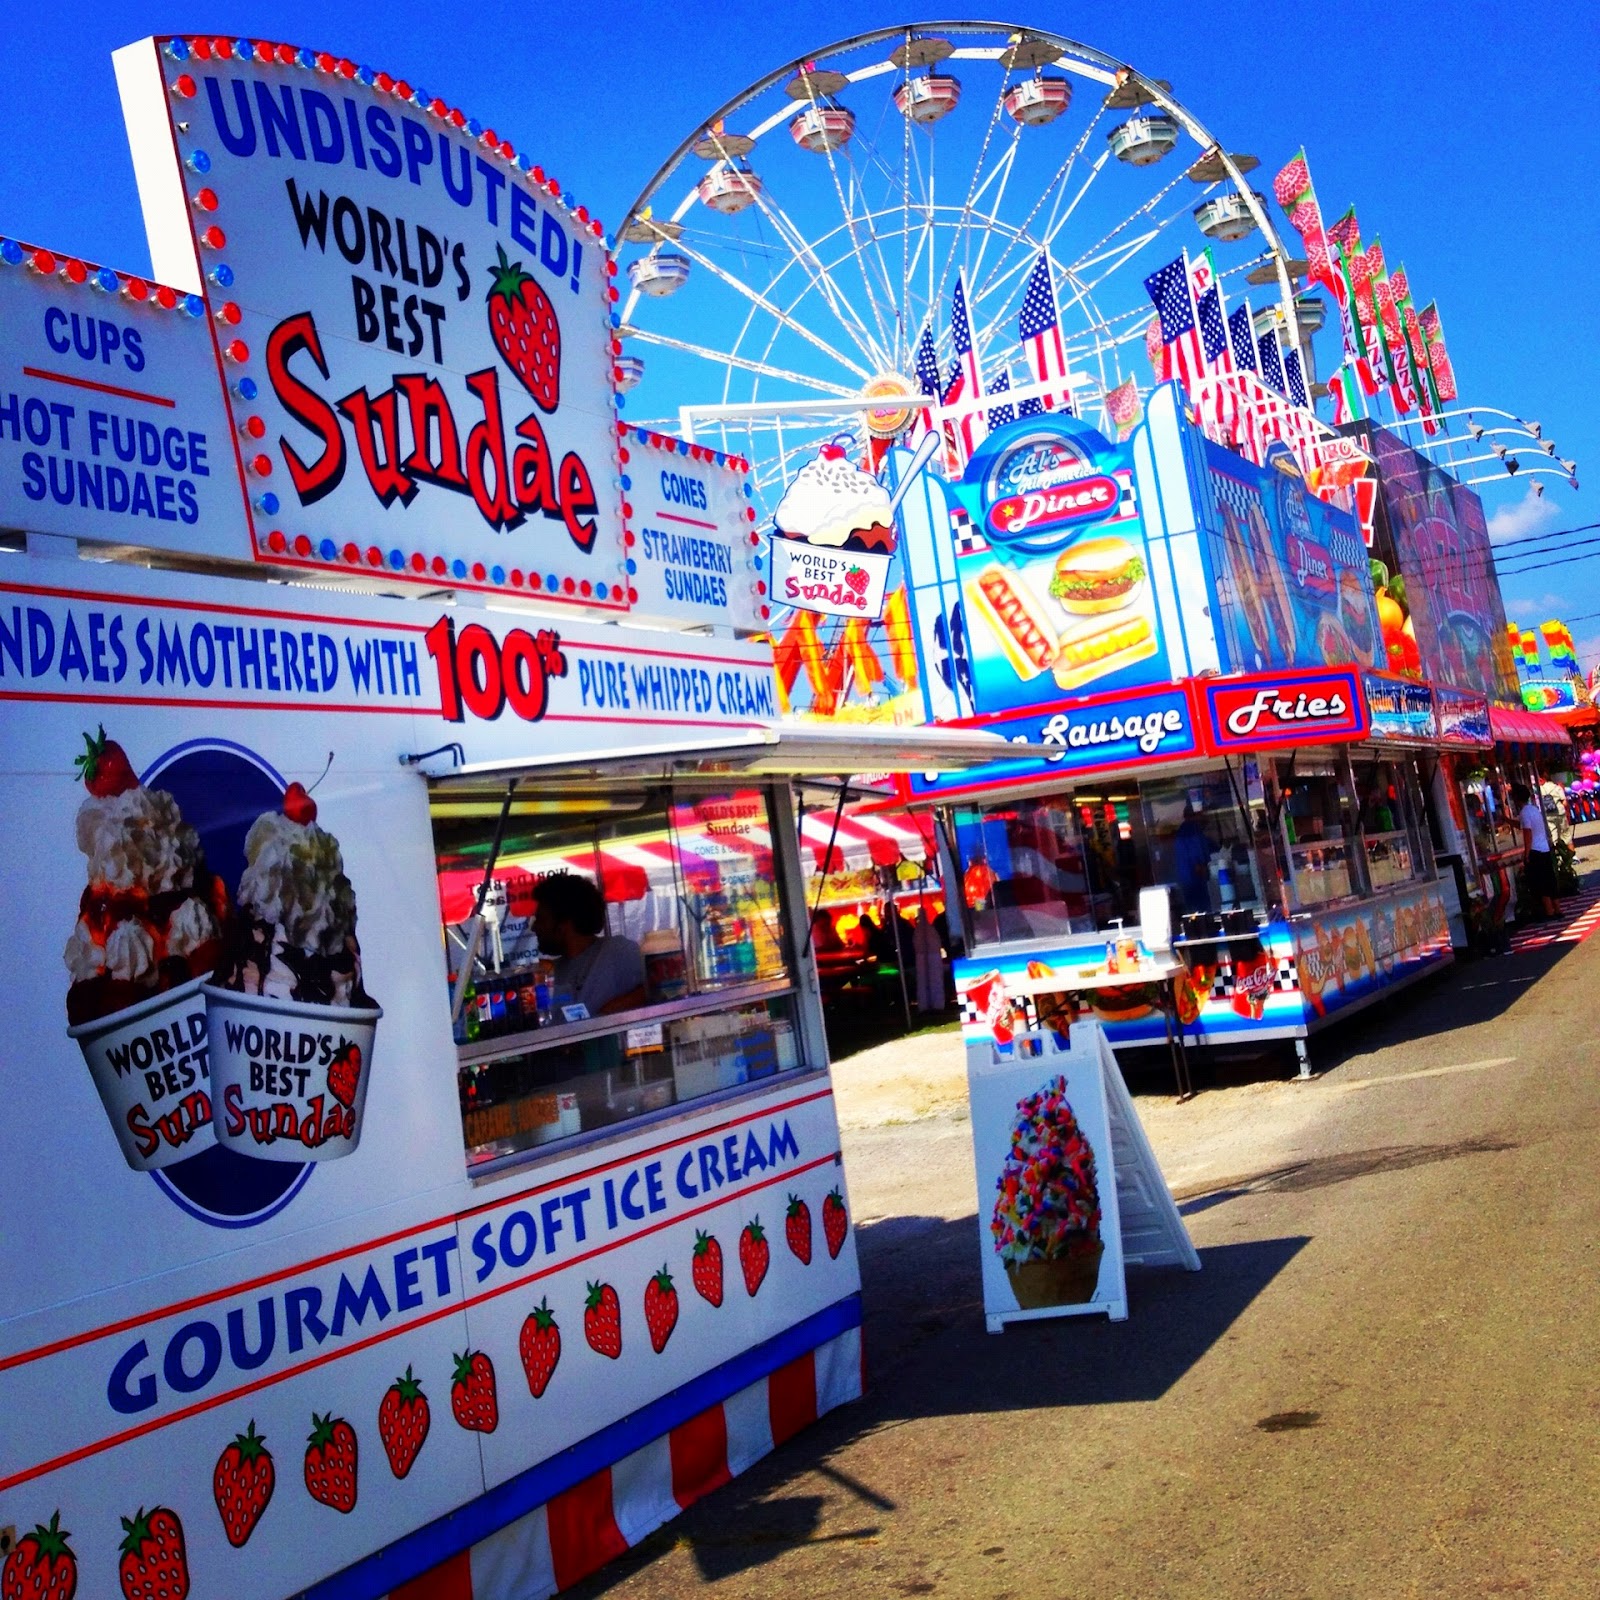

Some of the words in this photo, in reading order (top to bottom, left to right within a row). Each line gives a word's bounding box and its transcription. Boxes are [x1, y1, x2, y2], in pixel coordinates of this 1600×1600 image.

[204, 76, 584, 295] UNDISPUTED!
[285, 177, 472, 302] WORLD'S
[44, 307, 146, 372] CUPS
[351, 275, 447, 365] BEST
[0, 393, 75, 451] HOT
[88, 410, 210, 477] FUDGE
[265, 312, 599, 555] Sundae
[22, 451, 199, 525] SUNDAES
[661, 470, 707, 511] CONES
[1009, 449, 1060, 485] Al's
[1007, 487, 1109, 533] Diner
[642, 528, 732, 575] STRAWBERRY
[790, 552, 847, 572] WORLD'S
[804, 567, 835, 583] BEST
[1298, 541, 1329, 587] Diner
[664, 568, 728, 607] SUNDAES
[785, 576, 868, 610] Sundae
[0, 606, 128, 684] NDAES
[136, 618, 339, 693] SMOTHERED
[345, 636, 421, 697] WITH
[426, 614, 568, 723] 100%
[577, 658, 629, 710] PURE
[634, 664, 712, 716] WHIPPED
[716, 671, 775, 717] CREAM!
[1042, 709, 1183, 762] Sausage
[1228, 689, 1347, 735] Fries
[706, 821, 751, 836] Sundae
[106, 1012, 208, 1079] WORLD
[225, 1020, 333, 1066] WORLD'S
[145, 1050, 210, 1102] BEST
[250, 1062, 311, 1098] BEST
[127, 1089, 212, 1158] Sun
[224, 1084, 356, 1149] Sundae
[107, 1237, 457, 1414] GOURMET
[474, 1196, 590, 1283] SOFT
[604, 1160, 666, 1230] ICE
[676, 1118, 800, 1199] CREAM
